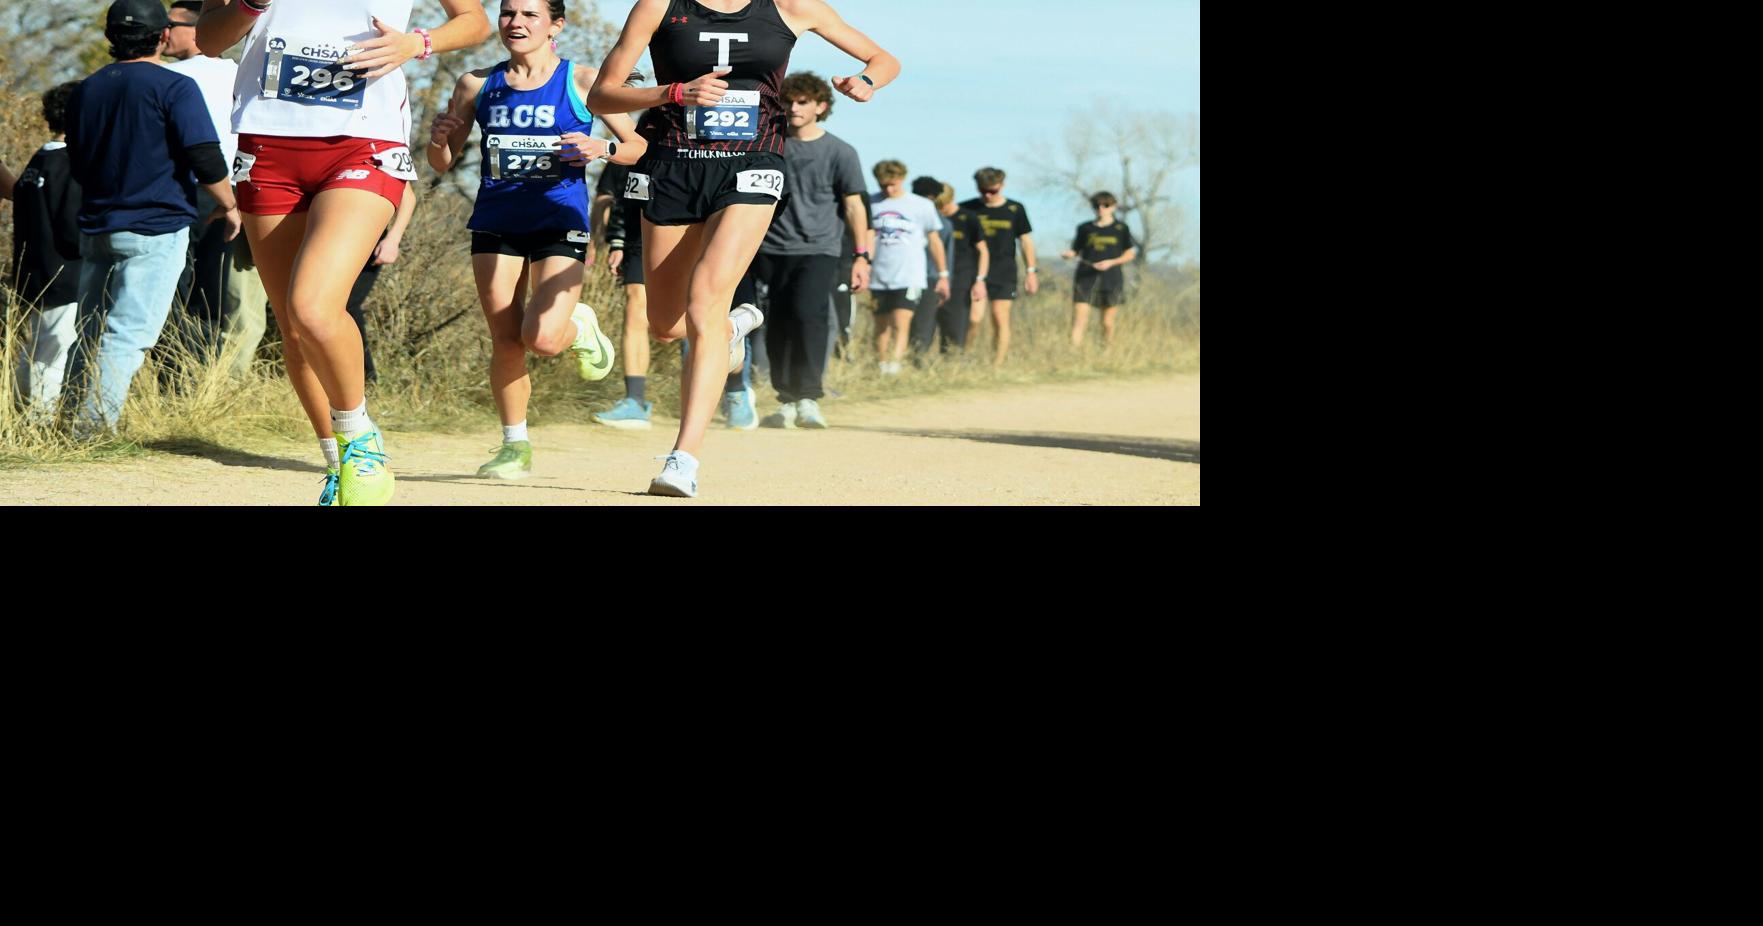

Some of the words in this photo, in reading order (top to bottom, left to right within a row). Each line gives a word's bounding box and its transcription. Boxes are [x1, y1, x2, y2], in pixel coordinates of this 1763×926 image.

[270, 40, 285, 50] 3A
[301, 47, 349, 59] CHSAA
[699, 32, 748, 72] T
[290, 65, 354, 91] 296
[487, 104, 556, 128] RCS
[703, 110, 750, 128] 292
[391, 152, 413, 173] 29
[507, 154, 552, 171] 276
[750, 173, 781, 192] 292
